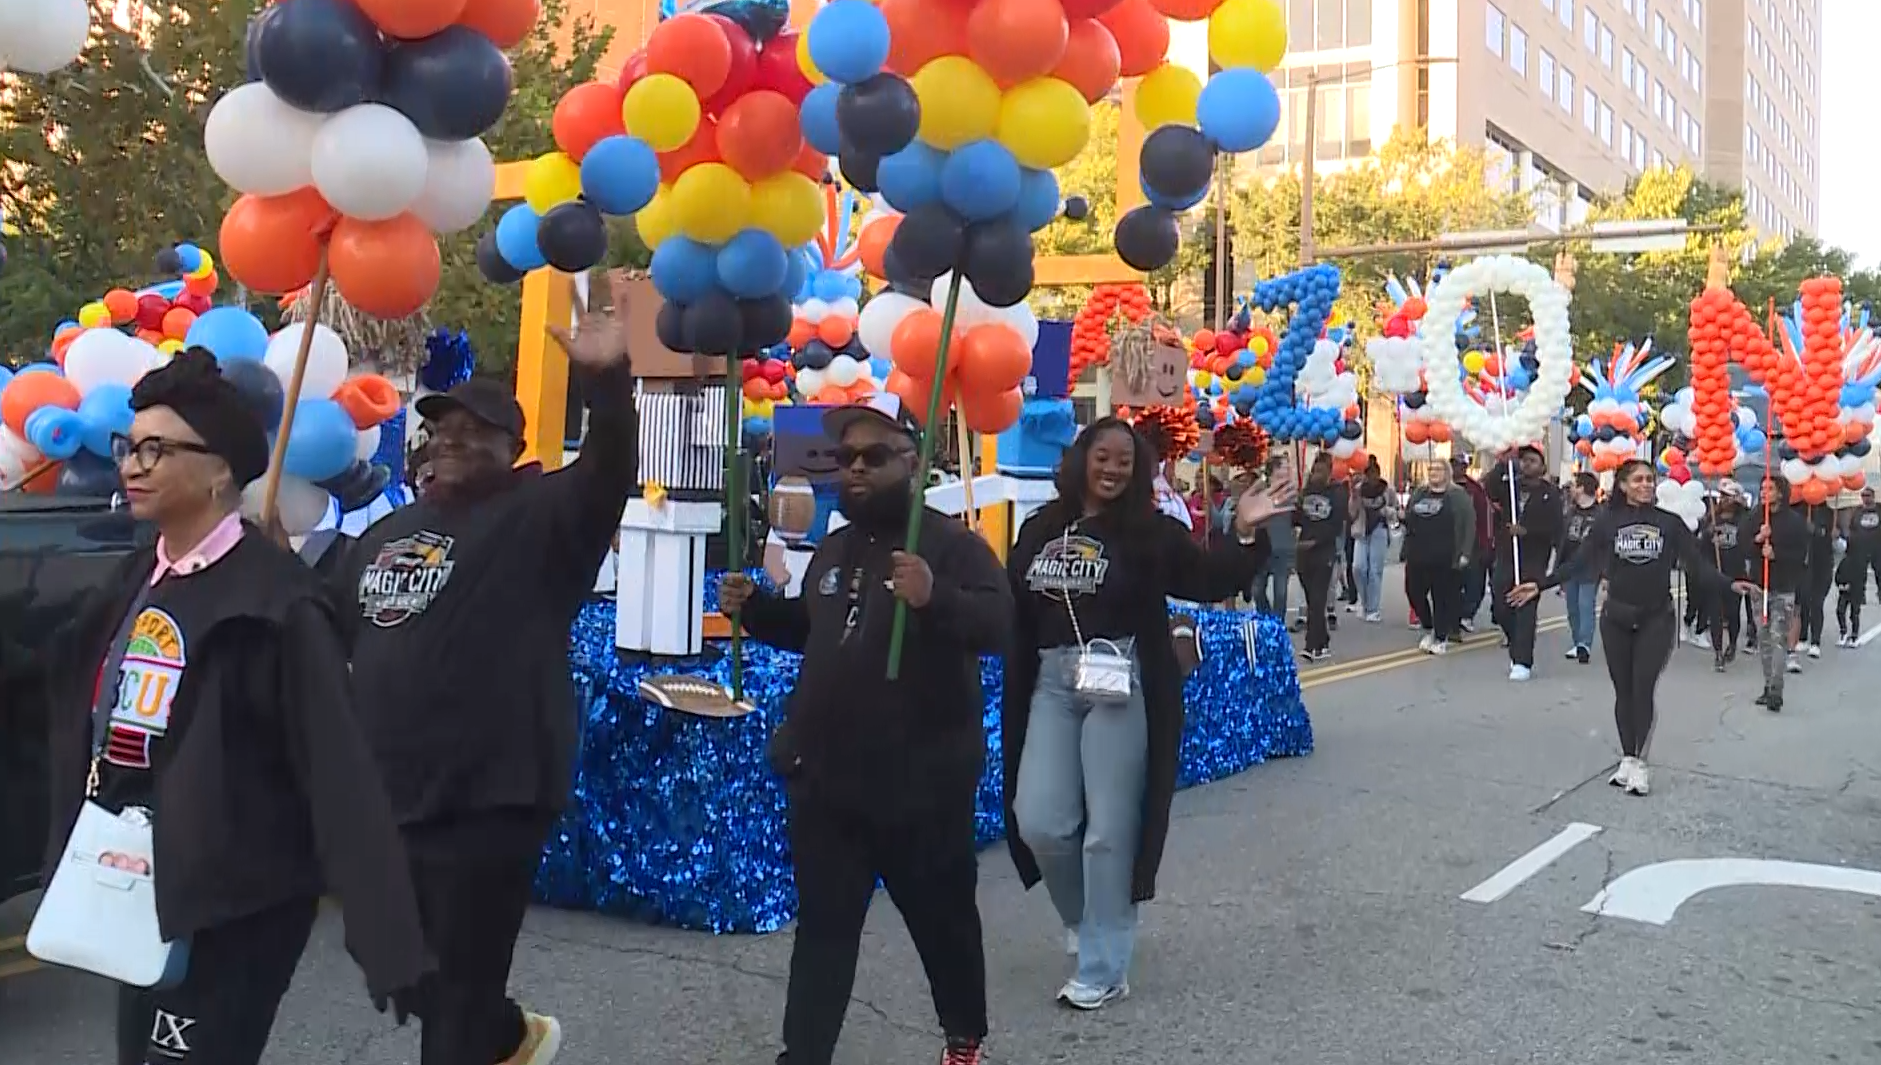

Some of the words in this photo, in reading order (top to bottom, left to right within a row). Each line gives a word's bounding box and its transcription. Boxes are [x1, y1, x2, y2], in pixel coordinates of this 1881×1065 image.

[1617, 538, 1641, 549] MAGIC
[1643, 538, 1661, 550] CITY
[1071, 560, 1102, 577] CITY
[408, 567, 442, 592] CITY
